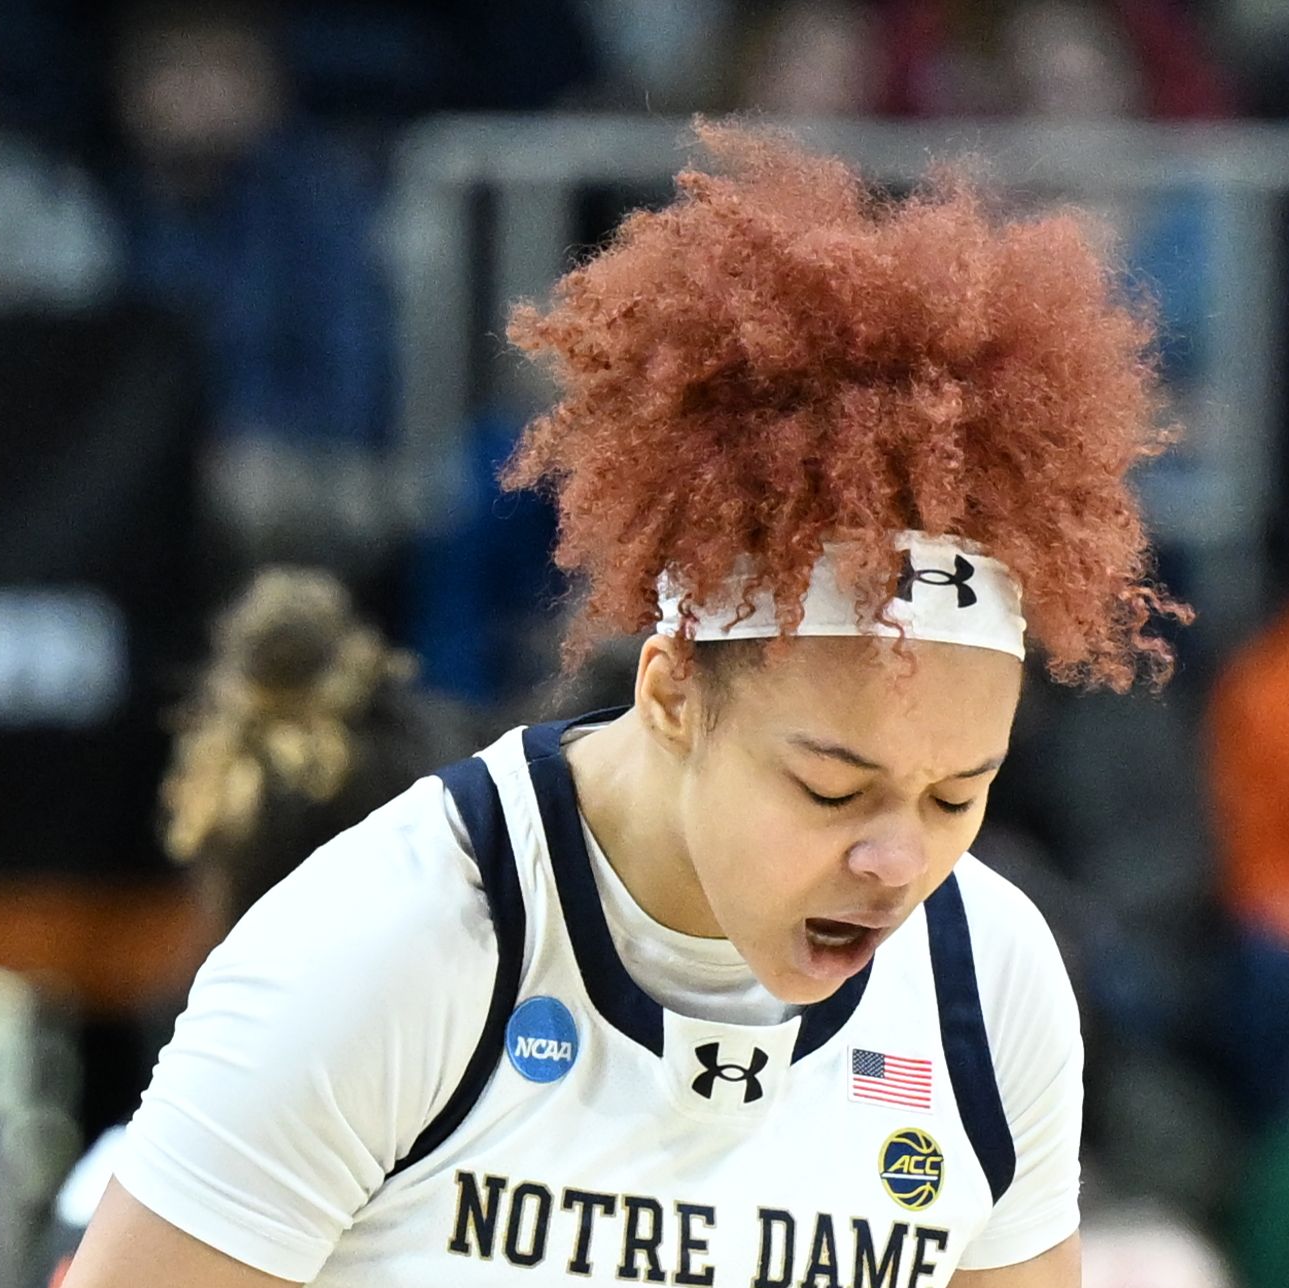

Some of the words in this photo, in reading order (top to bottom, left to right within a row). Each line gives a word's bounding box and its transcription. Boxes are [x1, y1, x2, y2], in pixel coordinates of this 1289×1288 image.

[515, 1035, 572, 1061] NCAA
[887, 1154, 944, 1175] ACC
[448, 1168, 716, 1288] NOTRE
